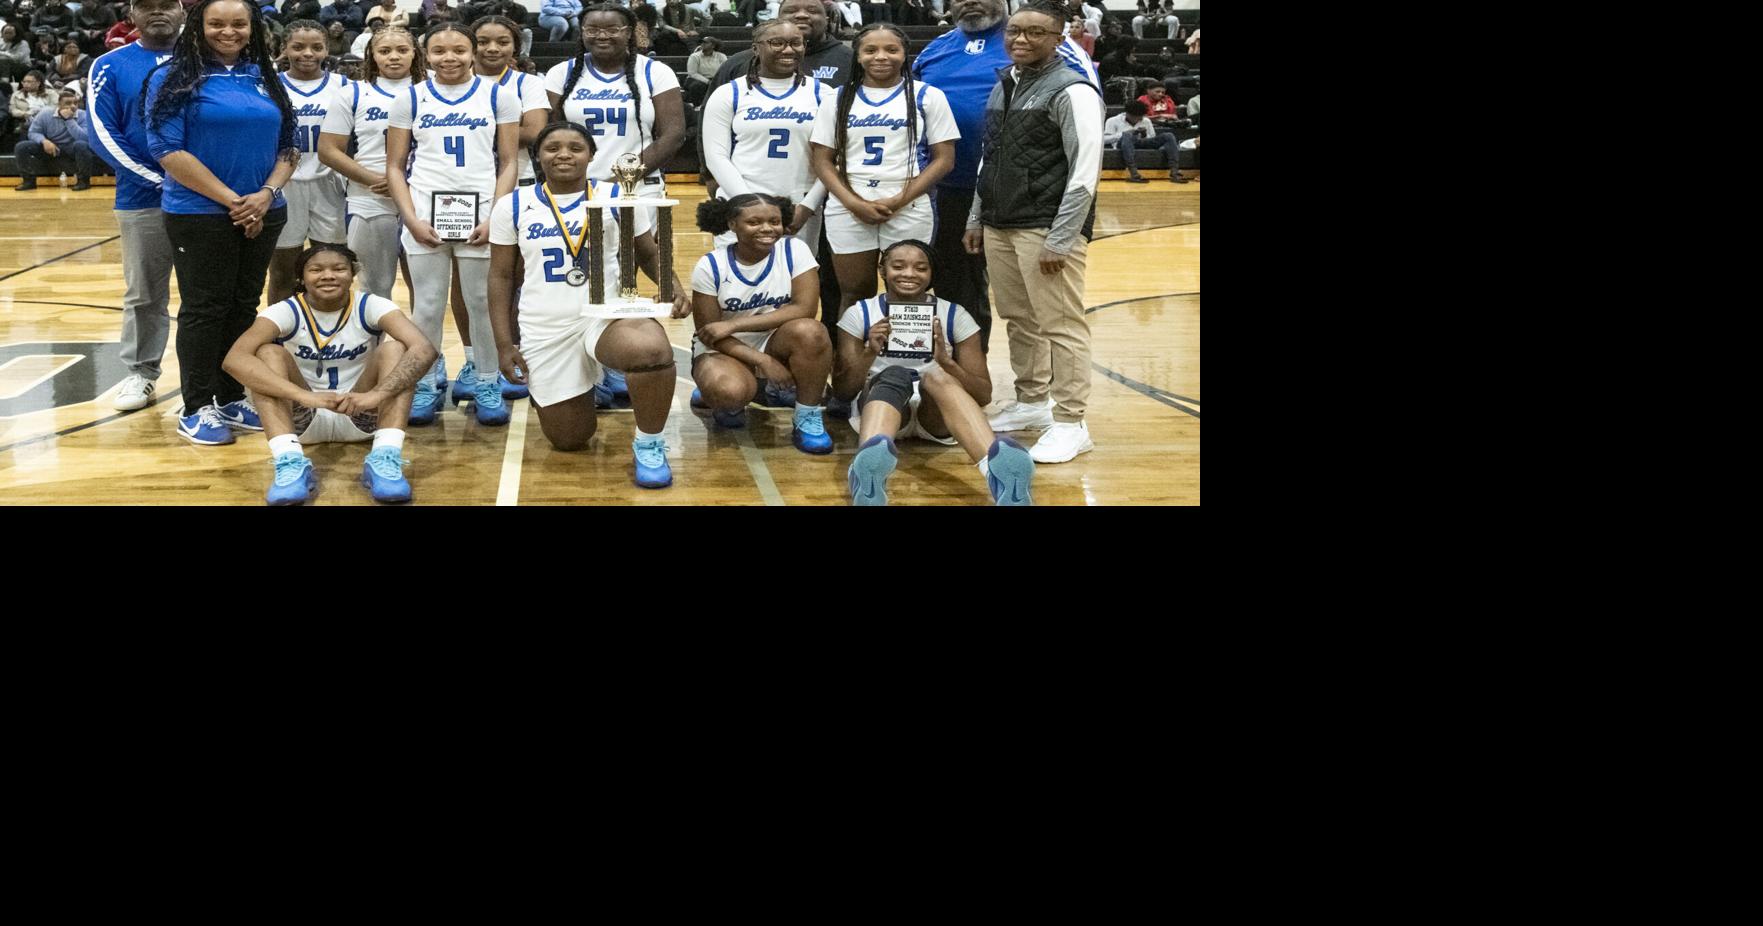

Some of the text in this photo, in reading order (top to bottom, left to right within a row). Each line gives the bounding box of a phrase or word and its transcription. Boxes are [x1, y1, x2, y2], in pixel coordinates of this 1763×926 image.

[572, 88, 634, 103] Bulldog
[419, 113, 489, 130] Bulldogs
[583, 108, 627, 136] 24
[744, 106, 815, 124] Bulldogs
[443, 136, 466, 168] 4
[768, 128, 790, 159] 2
[862, 136, 885, 165] 5
[721, 291, 792, 312] Bulldogs
[294, 343, 368, 361] Bulldogs
[326, 366, 339, 390] 1
